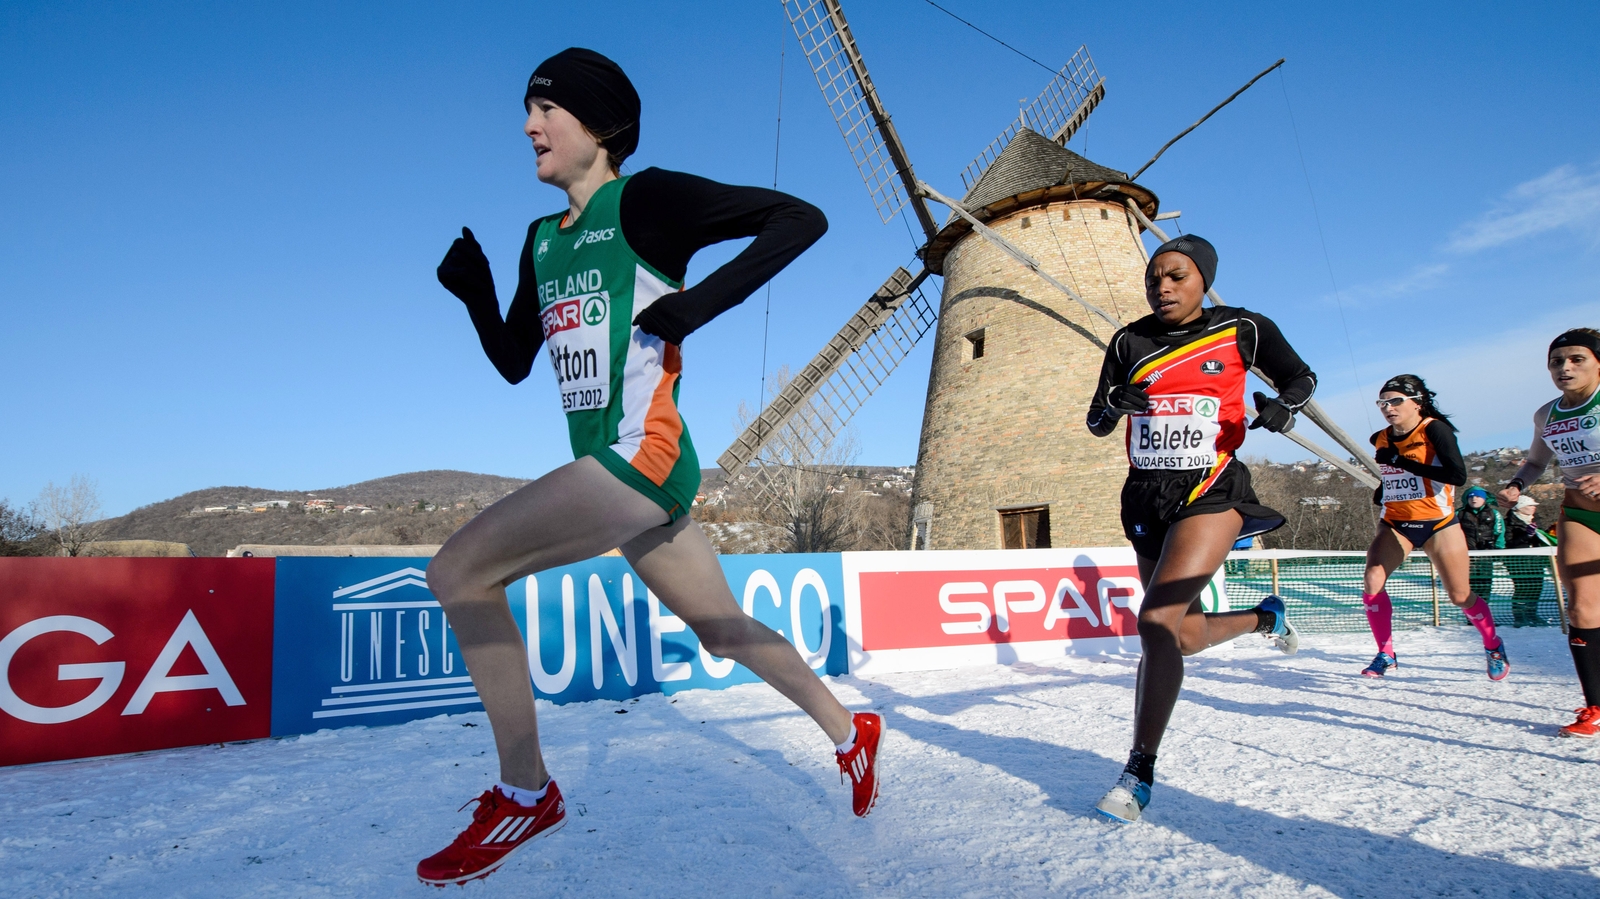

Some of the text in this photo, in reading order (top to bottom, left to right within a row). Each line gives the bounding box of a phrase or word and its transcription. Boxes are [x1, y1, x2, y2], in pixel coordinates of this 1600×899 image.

[537, 269, 603, 307] RELAND
[579, 388, 603, 407] 2012
[1136, 398, 1192, 414] PAR
[1139, 423, 1203, 450] Belete
[1551, 437, 1590, 454] Félix
[1134, 454, 1213, 468] BUDAPEST 2012
[1588, 452, 1600, 462] 20
[938, 576, 1145, 636] SPAR
[525, 567, 832, 695] UNECO
[341, 610, 468, 683] UNESC
